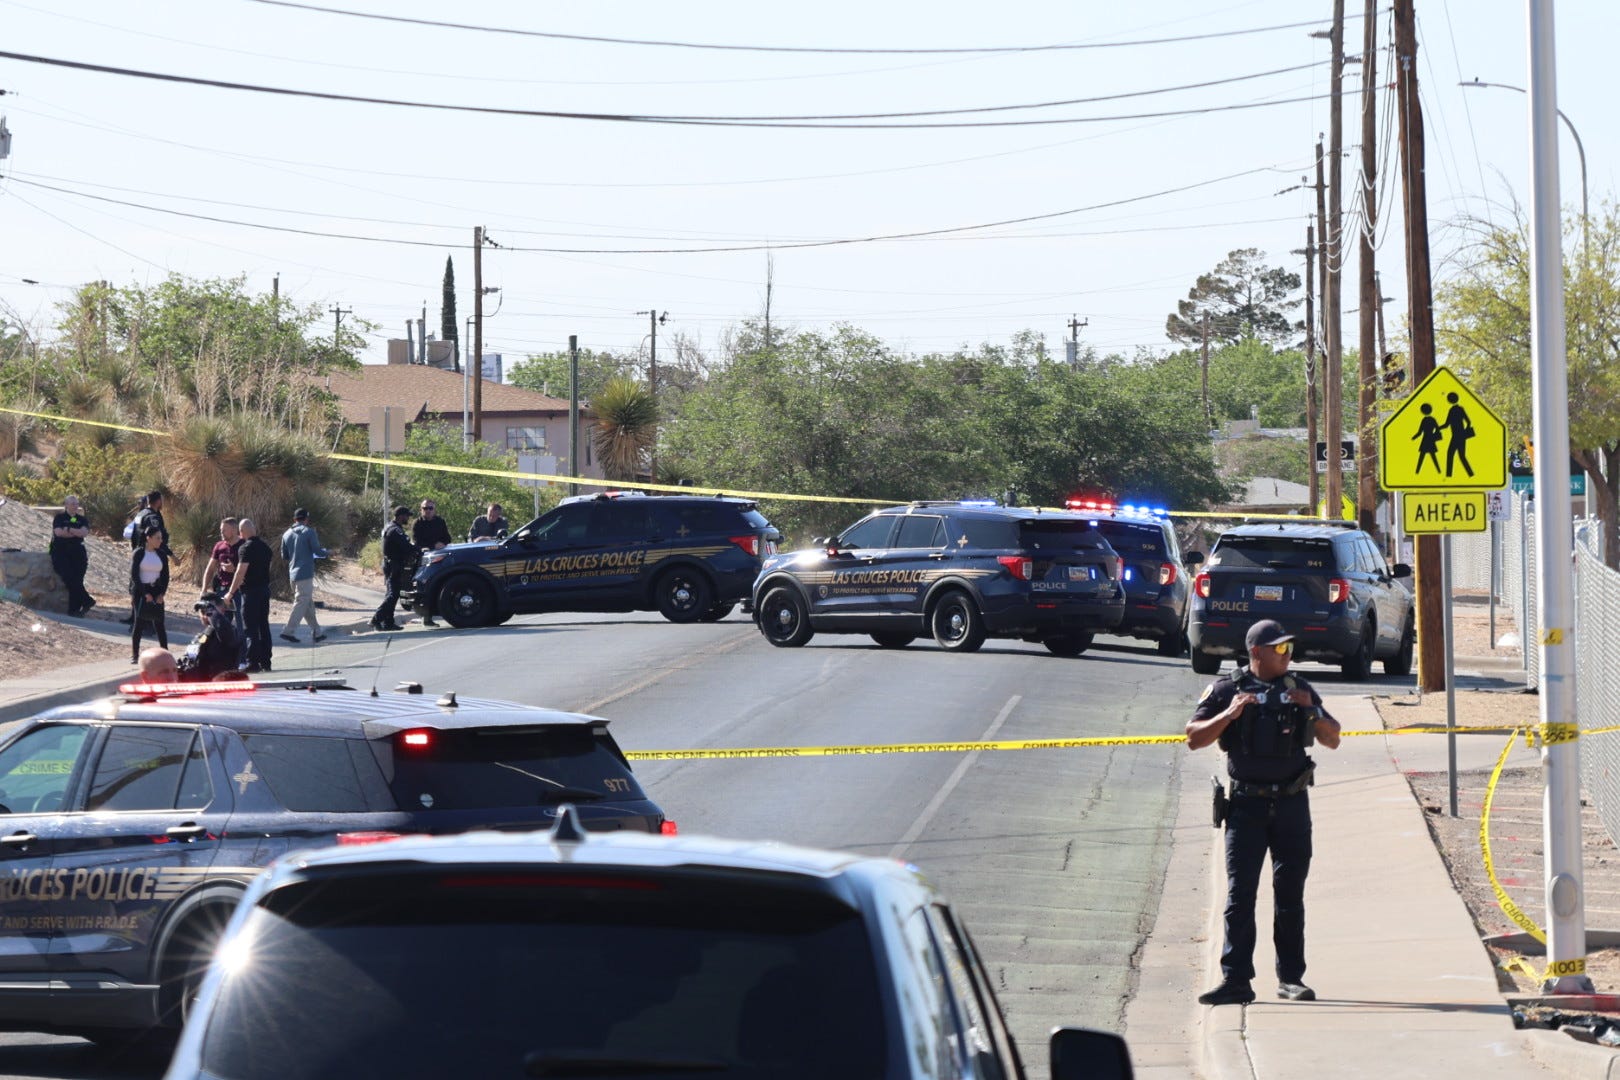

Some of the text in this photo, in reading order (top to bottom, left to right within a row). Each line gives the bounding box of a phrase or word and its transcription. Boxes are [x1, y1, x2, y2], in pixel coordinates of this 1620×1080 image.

[1414, 502, 1477, 523] AHEAD
[525, 550, 645, 574] LAS CRUCES POLICE
[1307, 560, 1323, 568] 941
[831, 569, 926, 585] LAS CRUCES POLICE
[1031, 581, 1067, 590] POLICE
[1211, 601, 1249, 612] POLICE
[625, 748, 800, 760] CRIME SCENE DO NOT CROSS
[823, 744, 999, 756] CRIME SCENE DO NOT CROSS
[603, 778, 631, 792] 977
[71, 867, 159, 901] POLICE
[4, 916, 29, 929] AND
[31, 916, 64, 929] SERVE
[65, 916, 95, 929] WITH
